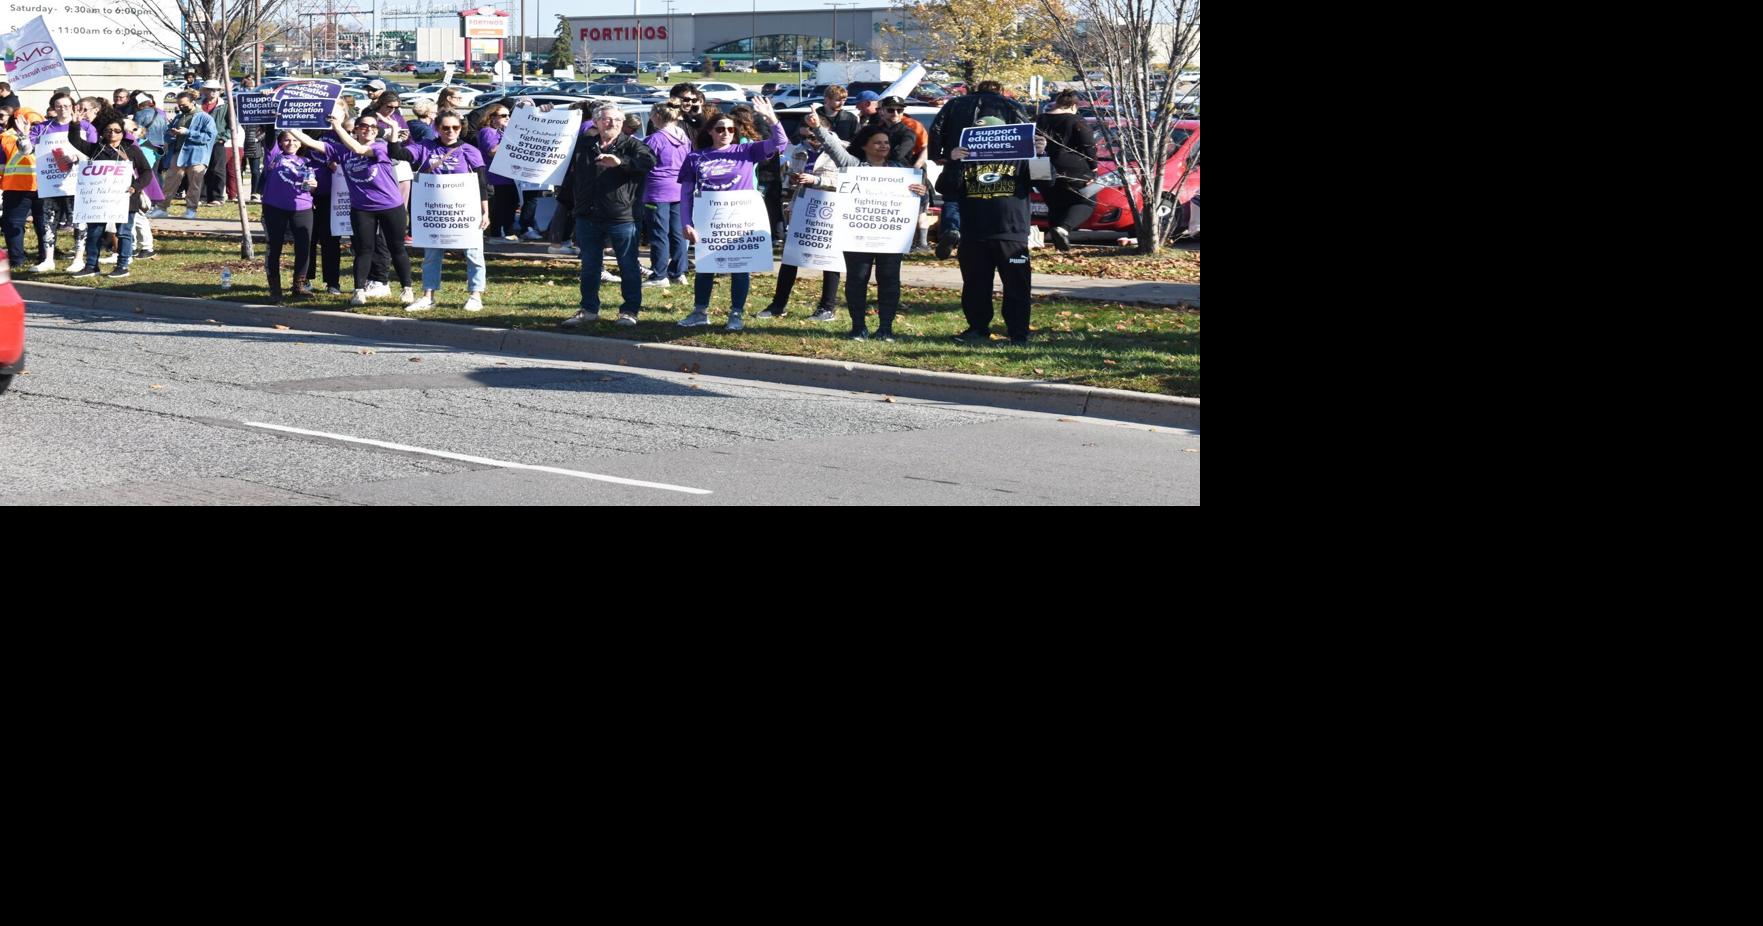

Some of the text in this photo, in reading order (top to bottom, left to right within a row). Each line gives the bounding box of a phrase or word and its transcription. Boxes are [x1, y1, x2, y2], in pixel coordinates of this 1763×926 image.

[64, 6, 100, 14] 9:30am
[580, 26, 668, 41] FORTINOS
[976, 128, 1017, 136] support
[520, 134, 550, 145] fighting
[968, 134, 1021, 142] education
[505, 144, 546, 157] SUCCESS
[518, 141, 559, 152] STUDENT
[509, 152, 535, 162] GOOD
[82, 165, 126, 176] CUPE
[839, 182, 860, 194] EA
[854, 198, 887, 207] fighting
[806, 203, 833, 220] EC
[855, 207, 900, 215] STUDENT
[842, 214, 887, 222] SUCCESS
[805, 228, 832, 236] STUDE
[798, 240, 824, 248] GOOD
